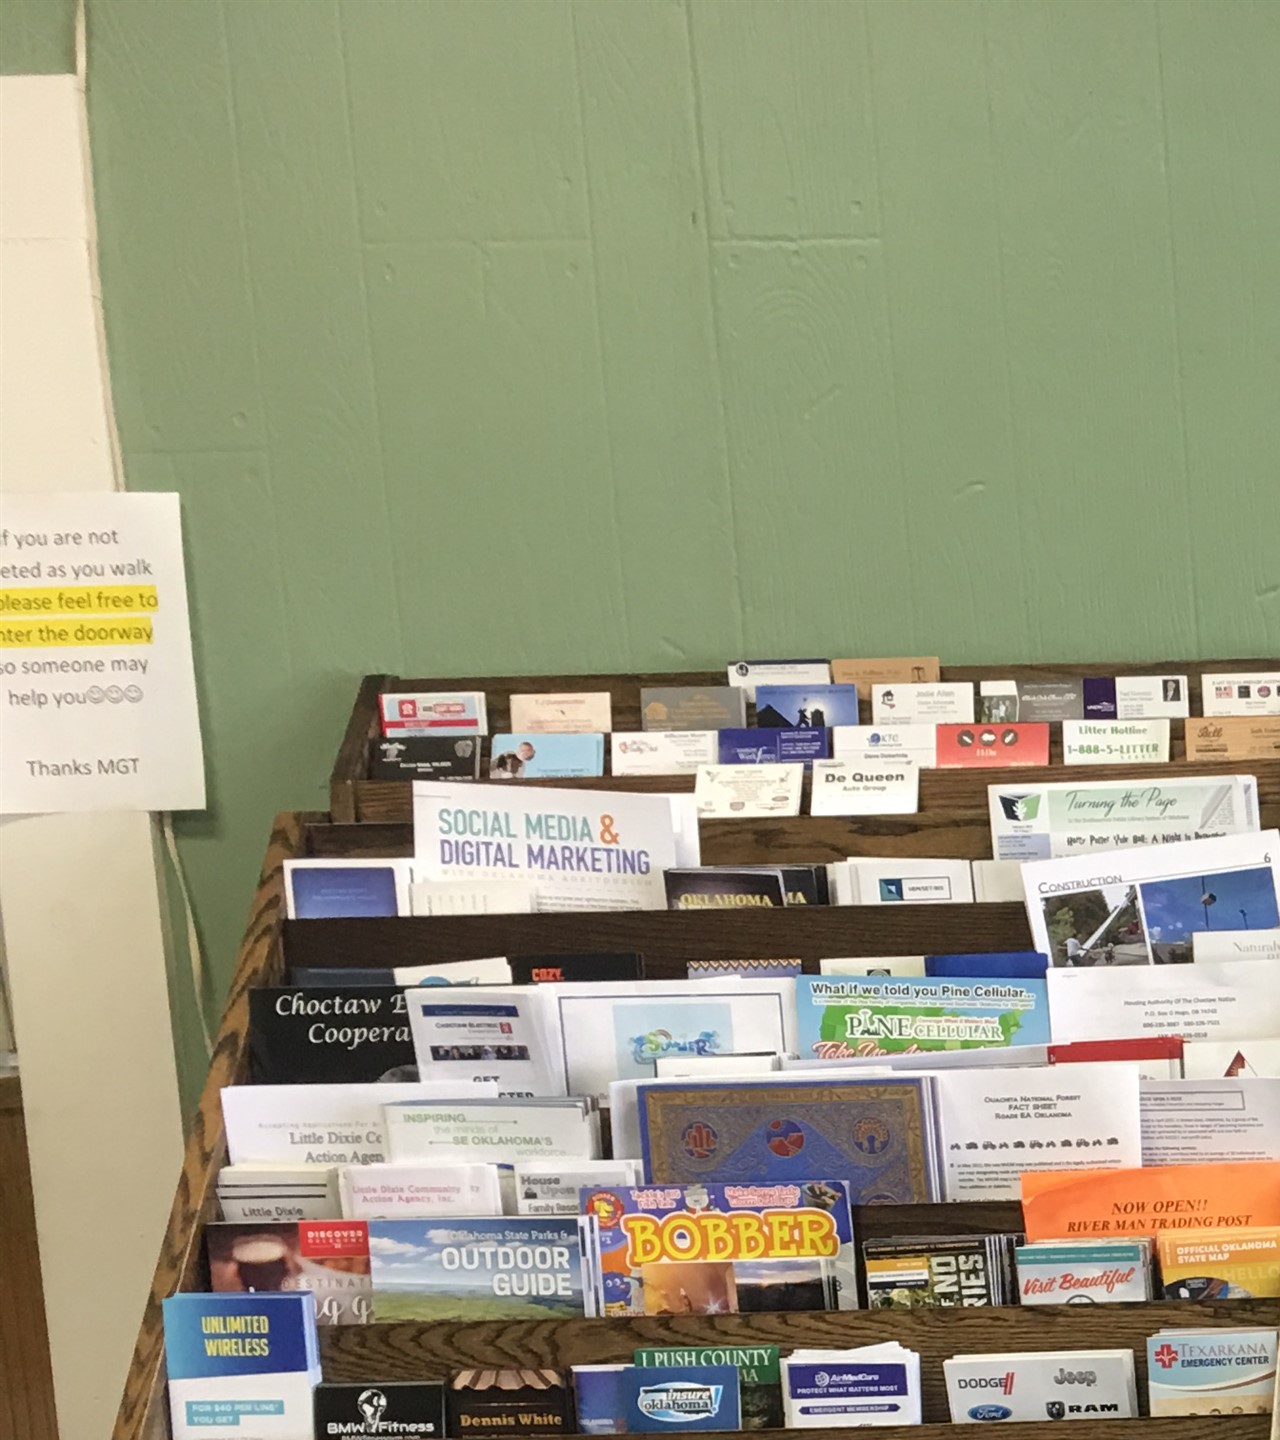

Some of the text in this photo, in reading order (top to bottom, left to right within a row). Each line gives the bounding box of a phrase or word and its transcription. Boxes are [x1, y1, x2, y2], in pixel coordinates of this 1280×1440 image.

[14, 529, 119, 549] you are not
[47, 559, 153, 580] as you walk
[58, 590, 158, 609] feel free to
[39, 623, 153, 644] the doorway
[22, 657, 148, 676] someone may
[9, 690, 47, 707] help
[1079, 725, 1148, 735] Litter Hotline
[27, 759, 139, 777] Thanks MGT
[825, 773, 905, 783] De Queen
[1065, 787, 1177, 817] Turning the Page
[438, 808, 619, 844] SOCIAL MEDIA &
[440, 839, 650, 875] DIGITAL MARKETING
[1038, 852, 1271, 894] CONSTRUCTION 6
[811, 983, 970, 998] What if we told you Pine
[275, 993, 382, 1016] Choctaw
[308, 1023, 411, 1050] Coopera
[914, 1026, 1002, 1038] CELLULAR
[403, 1113, 466, 1123] INSPIRING
[290, 1132, 362, 1145] Little Dixie
[452, 1136, 469, 1146] SE
[305, 1151, 347, 1164] Action
[1112, 1199, 1208, 1215] NOW OPEN!!
[1068, 1215, 1252, 1232] RIVER MAN TRADING POST
[505, 1229, 556, 1241] State Parks
[624, 1212, 836, 1264] BOBBER
[1223, 1241, 1277, 1252] OKLAHOMA
[441, 1247, 570, 1271] OUTDOOR
[494, 1273, 573, 1296] GUIDE
[1024, 1268, 1134, 1296] Visit Beautiful
[202, 1316, 270, 1333] UNLIMITED
[204, 1339, 270, 1357] WIRELESS
[1178, 1342, 1270, 1358] TEXARKANA
[701, 1350, 770, 1366] COUNTY
[1180, 1354, 1269, 1369] EMERGENCY CENTER
[958, 1377, 1006, 1390] DODGE
[1053, 1368, 1098, 1387] Jeep
[976, 1405, 1004, 1421] Ford
[1068, 1402, 1118, 1413] RAM
[327, 1421, 434, 1435] BMW Fitness
[460, 1413, 562, 1427] Dennis White
